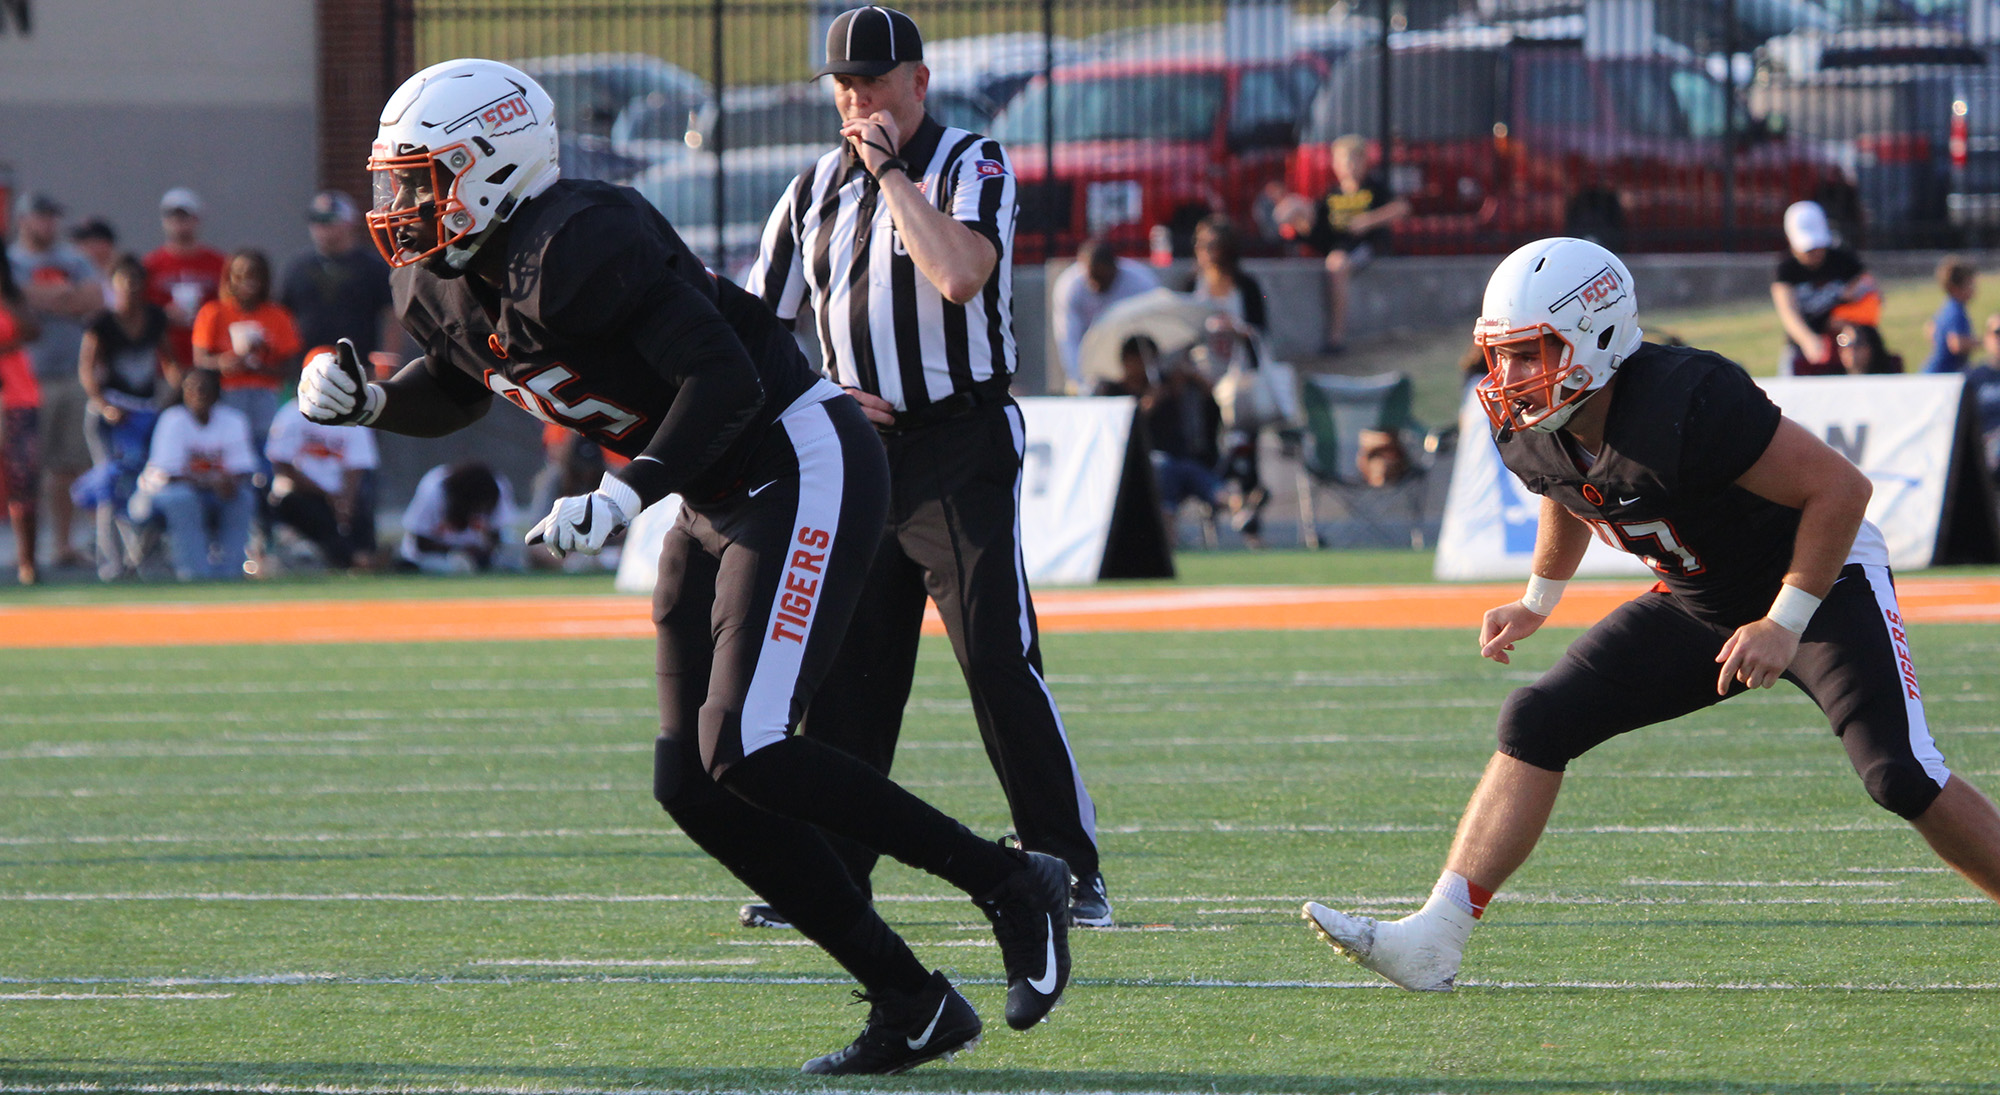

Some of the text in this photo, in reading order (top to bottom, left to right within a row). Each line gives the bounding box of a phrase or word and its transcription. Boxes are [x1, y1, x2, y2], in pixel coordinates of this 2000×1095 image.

[481, 97, 528, 129] ECU
[1581, 271, 1619, 305] ECU
[771, 526, 830, 645] TIGERS
[1885, 608, 1920, 700] TIGERS
